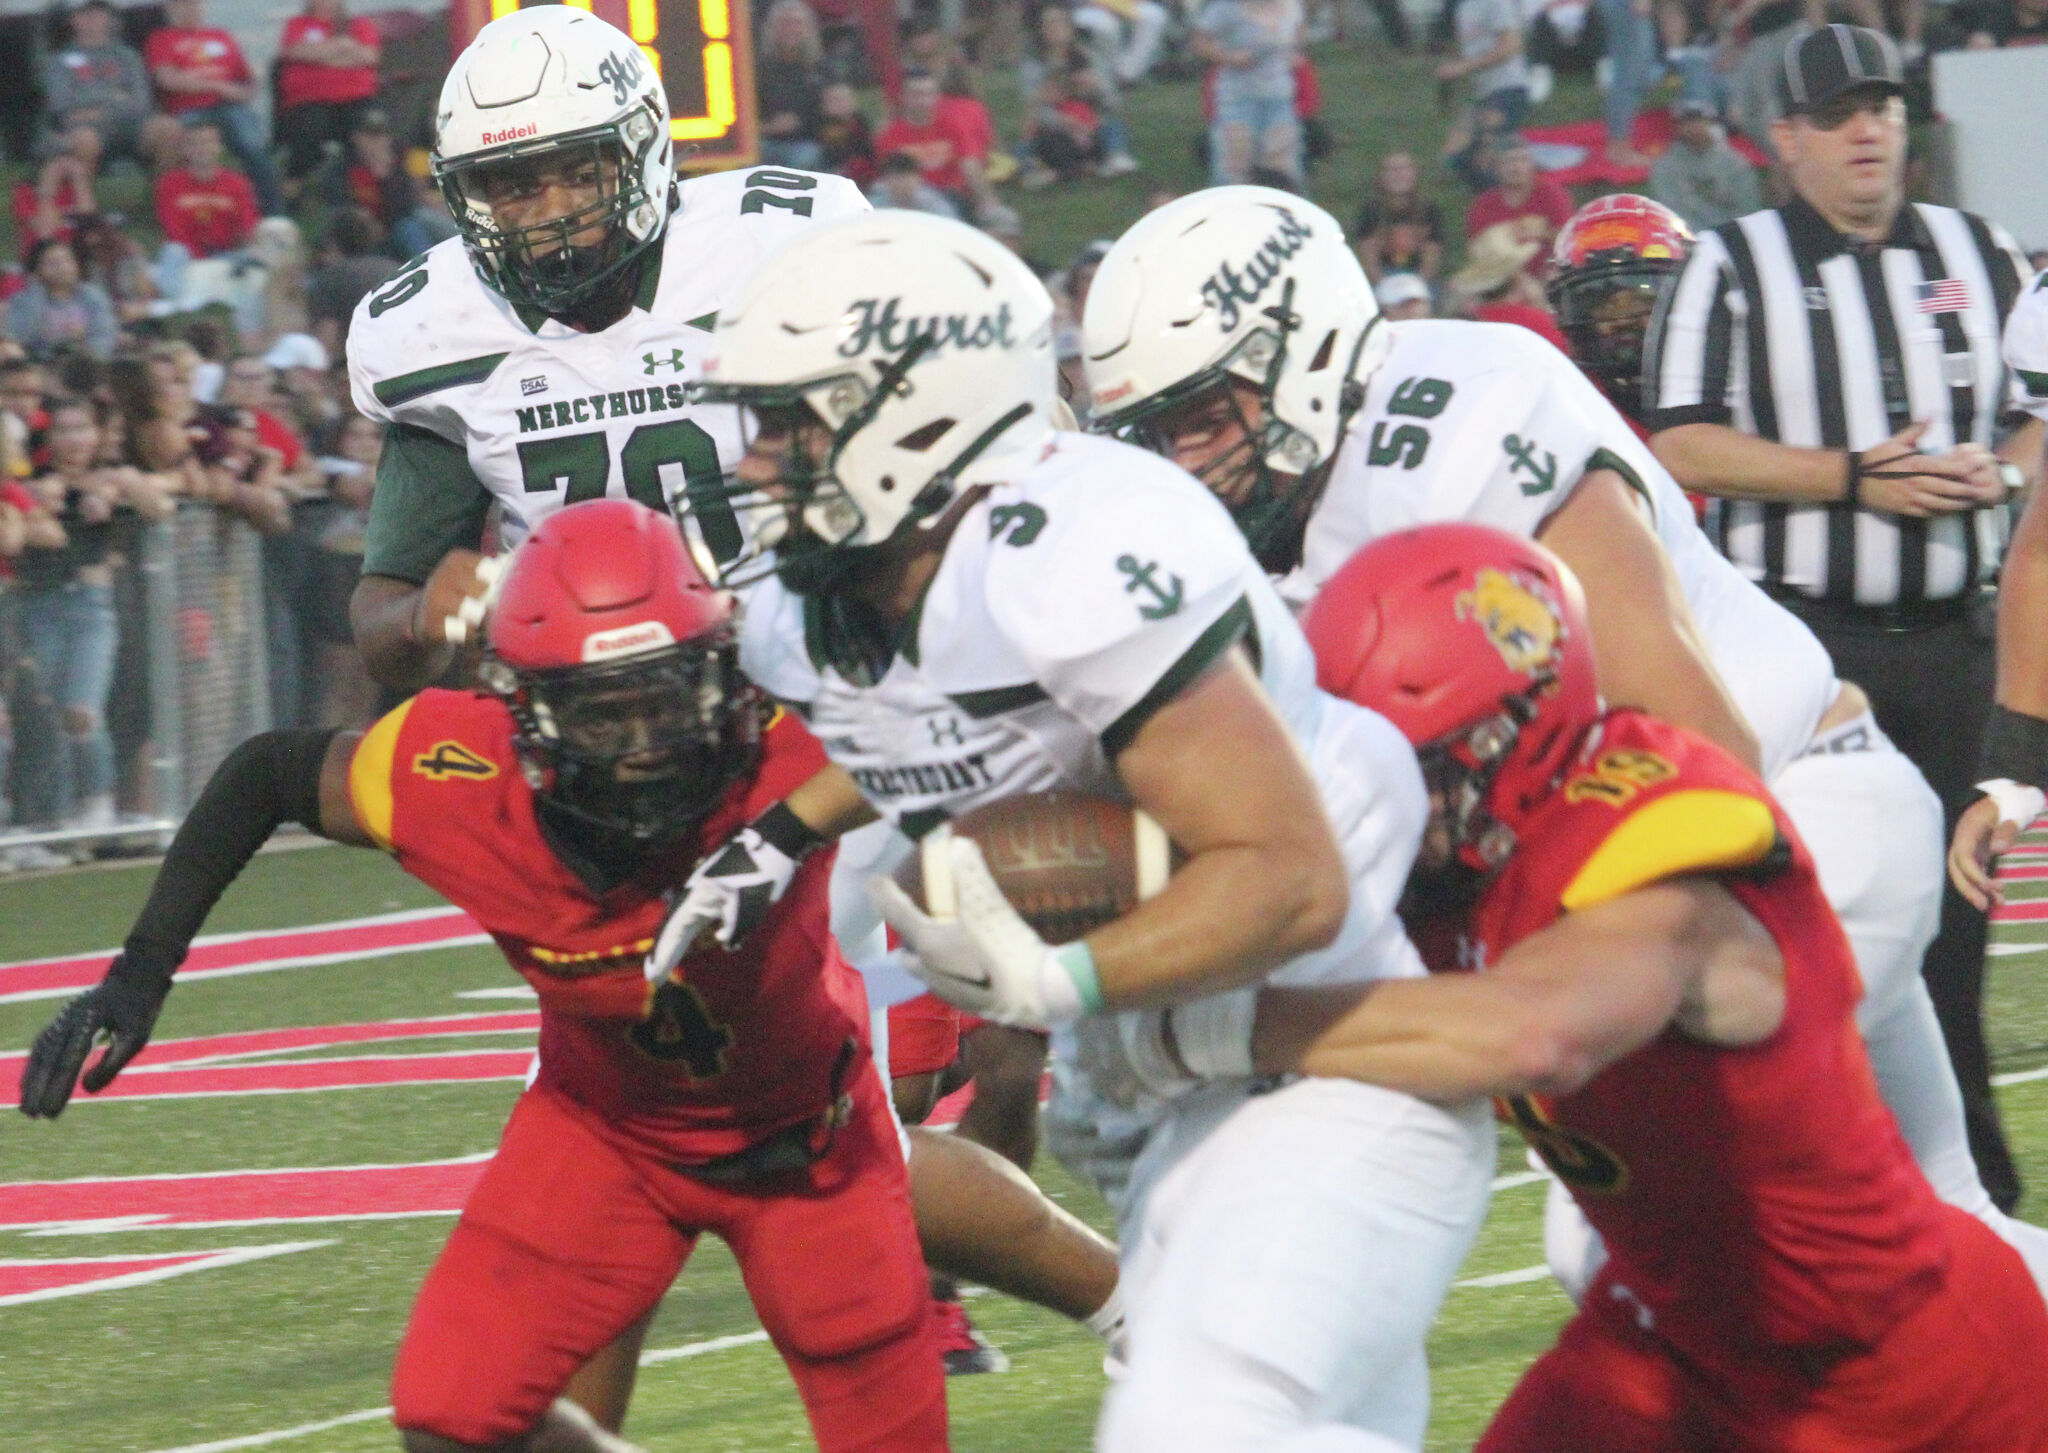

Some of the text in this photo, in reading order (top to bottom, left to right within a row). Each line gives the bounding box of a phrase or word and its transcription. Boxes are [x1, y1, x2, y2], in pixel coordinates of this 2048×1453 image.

[482, 121, 538, 146] Riddell
[464, 206, 501, 234] Ridde
[739, 170, 818, 218] 70
[1201, 205, 1315, 333] Hurst
[837, 296, 1019, 358] Hurst
[1364, 375, 1454, 471] 56
[412, 740, 500, 781] 4
[624, 968, 738, 1081] 4
